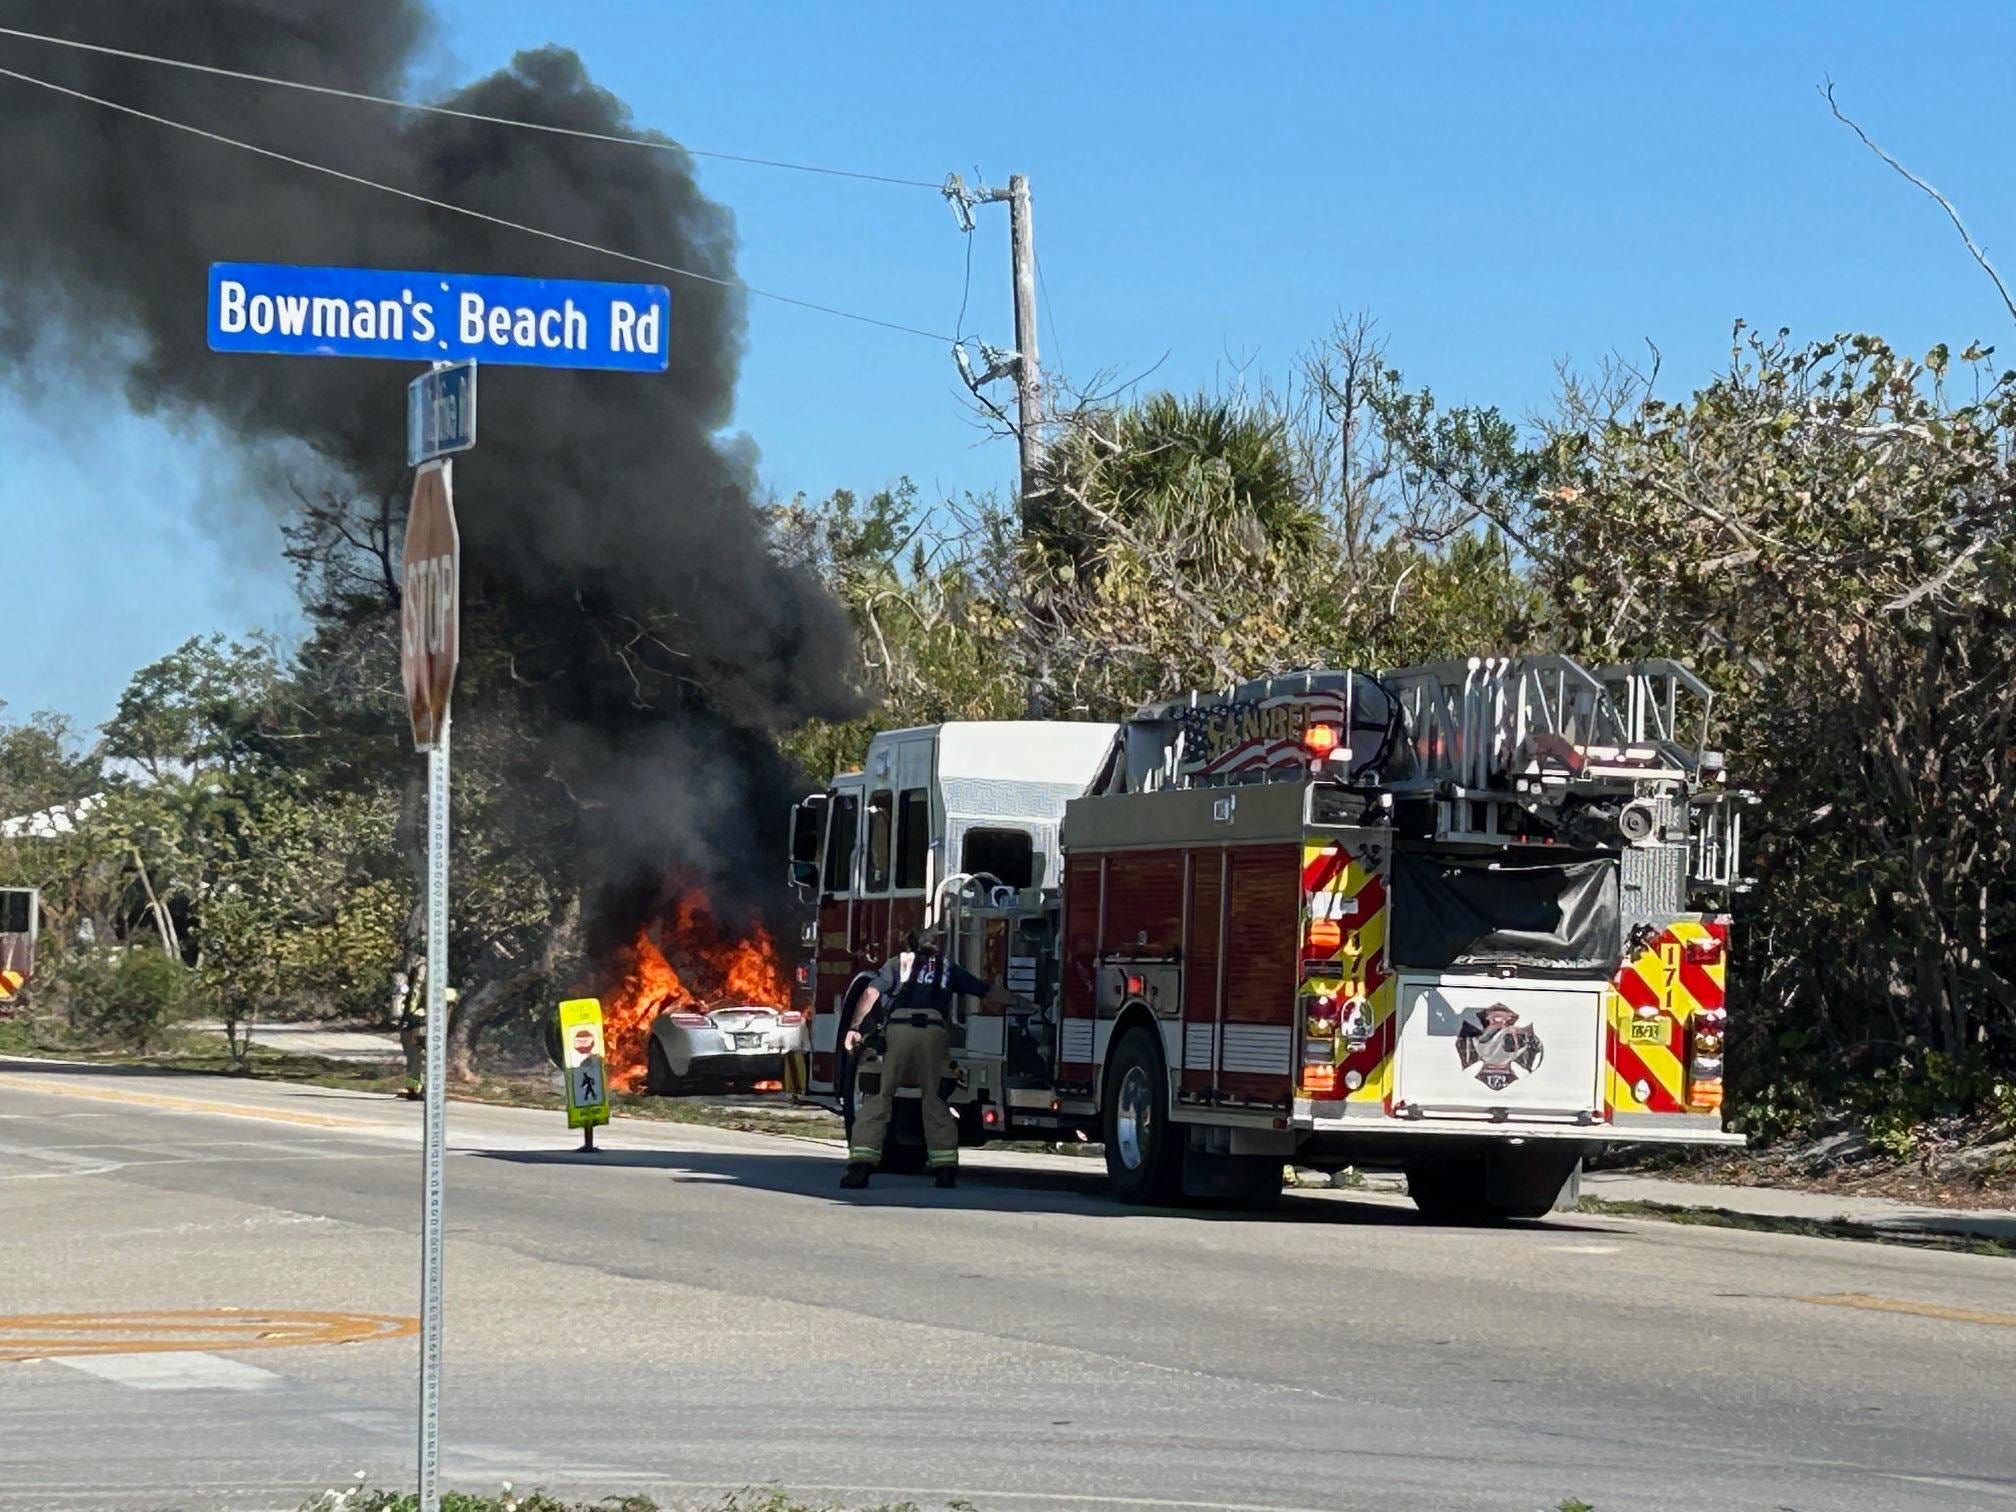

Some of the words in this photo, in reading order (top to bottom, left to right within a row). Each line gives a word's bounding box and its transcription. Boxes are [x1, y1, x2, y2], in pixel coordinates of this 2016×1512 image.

[220, 280, 435, 343] Bowman's
[459, 292, 588, 351] Beach
[610, 301, 660, 355] Rd
[405, 554, 451, 656] STOP
[1662, 946, 1676, 1008] 171
